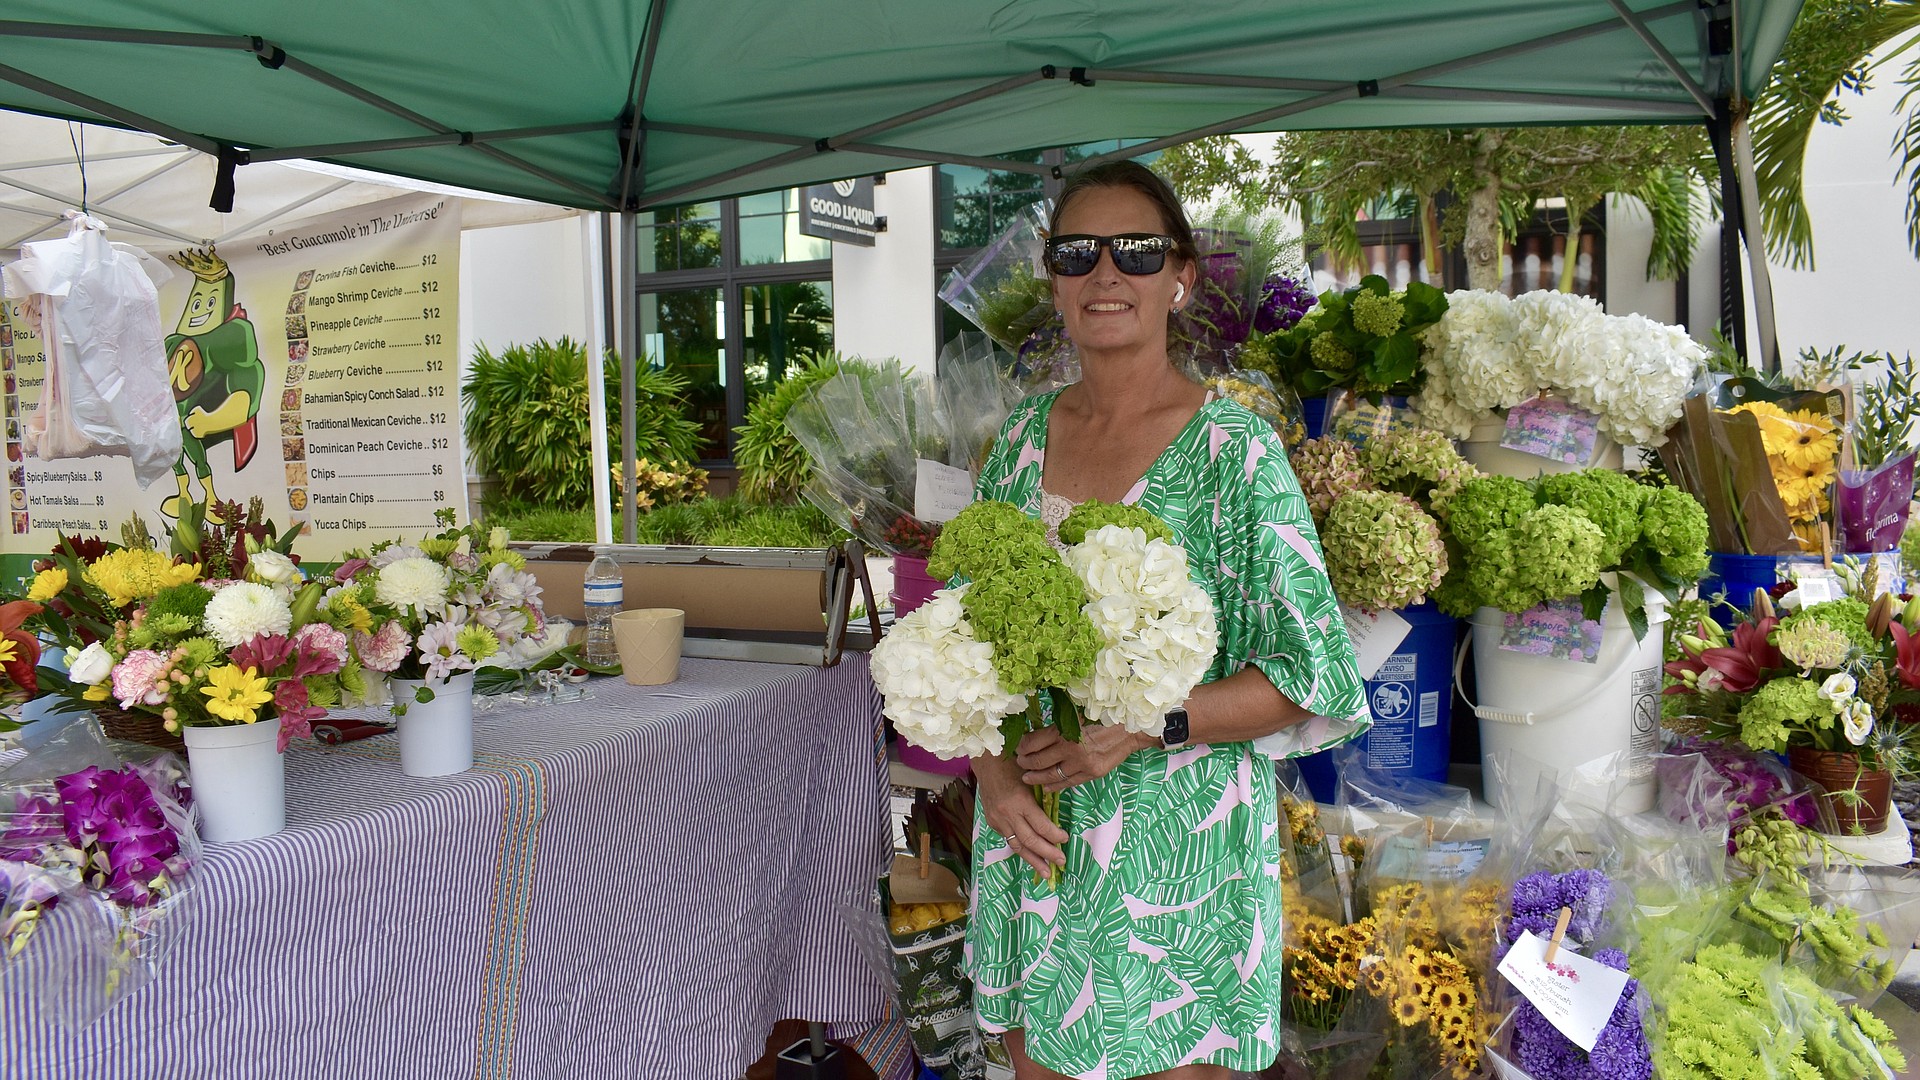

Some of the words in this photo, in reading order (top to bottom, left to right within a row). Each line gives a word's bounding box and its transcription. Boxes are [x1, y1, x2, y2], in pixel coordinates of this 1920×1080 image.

[810, 198, 841, 218] GOOD
[843, 205, 875, 226] LIQUID
[291, 226, 356, 250] Guacamole
[357, 223, 370, 238] in
[370, 218, 391, 235] The
[315, 271, 341, 283] Corvina
[341, 266, 358, 277] Fish
[359, 261, 396, 274] Ceviche
[422, 254, 437, 266] $12
[308, 294, 335, 307] Mango
[337, 286, 369, 303] Shrimp
[371, 286, 403, 300] Ceviche
[421, 281, 438, 294] $12
[310, 317, 351, 332] Pineapple
[353, 314, 383, 327] Ceviche
[423, 307, 440, 320] $12
[13, 330, 28, 340] Pico
[312, 343, 352, 357] Strawberry
[353, 339, 386, 352] Ceviche
[424, 334, 442, 346] $12
[16, 353, 36, 365] Mango
[308, 368, 345, 381] Blueberry
[346, 365, 383, 377] Ceviche
[427, 361, 443, 372] $12
[19, 378, 45, 388] Strawberr
[304, 391, 344, 404] Bahamian
[344, 390, 368, 404] Spicy
[368, 389, 395, 400] Conch
[396, 387, 420, 399] Salad
[428, 386, 444, 398] $12
[306, 417, 350, 430] Traditional
[351, 416, 386, 428] Mexican
[387, 415, 422, 427] Ceviche
[430, 413, 447, 425] $12
[309, 443, 355, 454] Dominican
[357, 441, 385, 452] Peach
[387, 440, 423, 451] Ceviche
[432, 438, 448, 450] $12
[94, 471, 103, 482] $8
[311, 469, 336, 481] Chips
[432, 464, 443, 476] $6
[29, 496, 42, 506] Hot
[42, 495, 63, 506] Tamale
[64, 495, 79, 506] Salsa
[95, 496, 104, 506] $8
[313, 493, 347, 504] Plantain
[349, 492, 374, 505] Chips
[433, 490, 444, 501] $8
[32, 519, 62, 530] Caribbean
[62, 519, 77, 529] Peach
[77, 520, 91, 530] Salsa
[99, 520, 108, 530] $8
[314, 519, 340, 530] Yucca
[342, 518, 367, 531] Chips
[1383, 656, 1413, 664] ARNING
